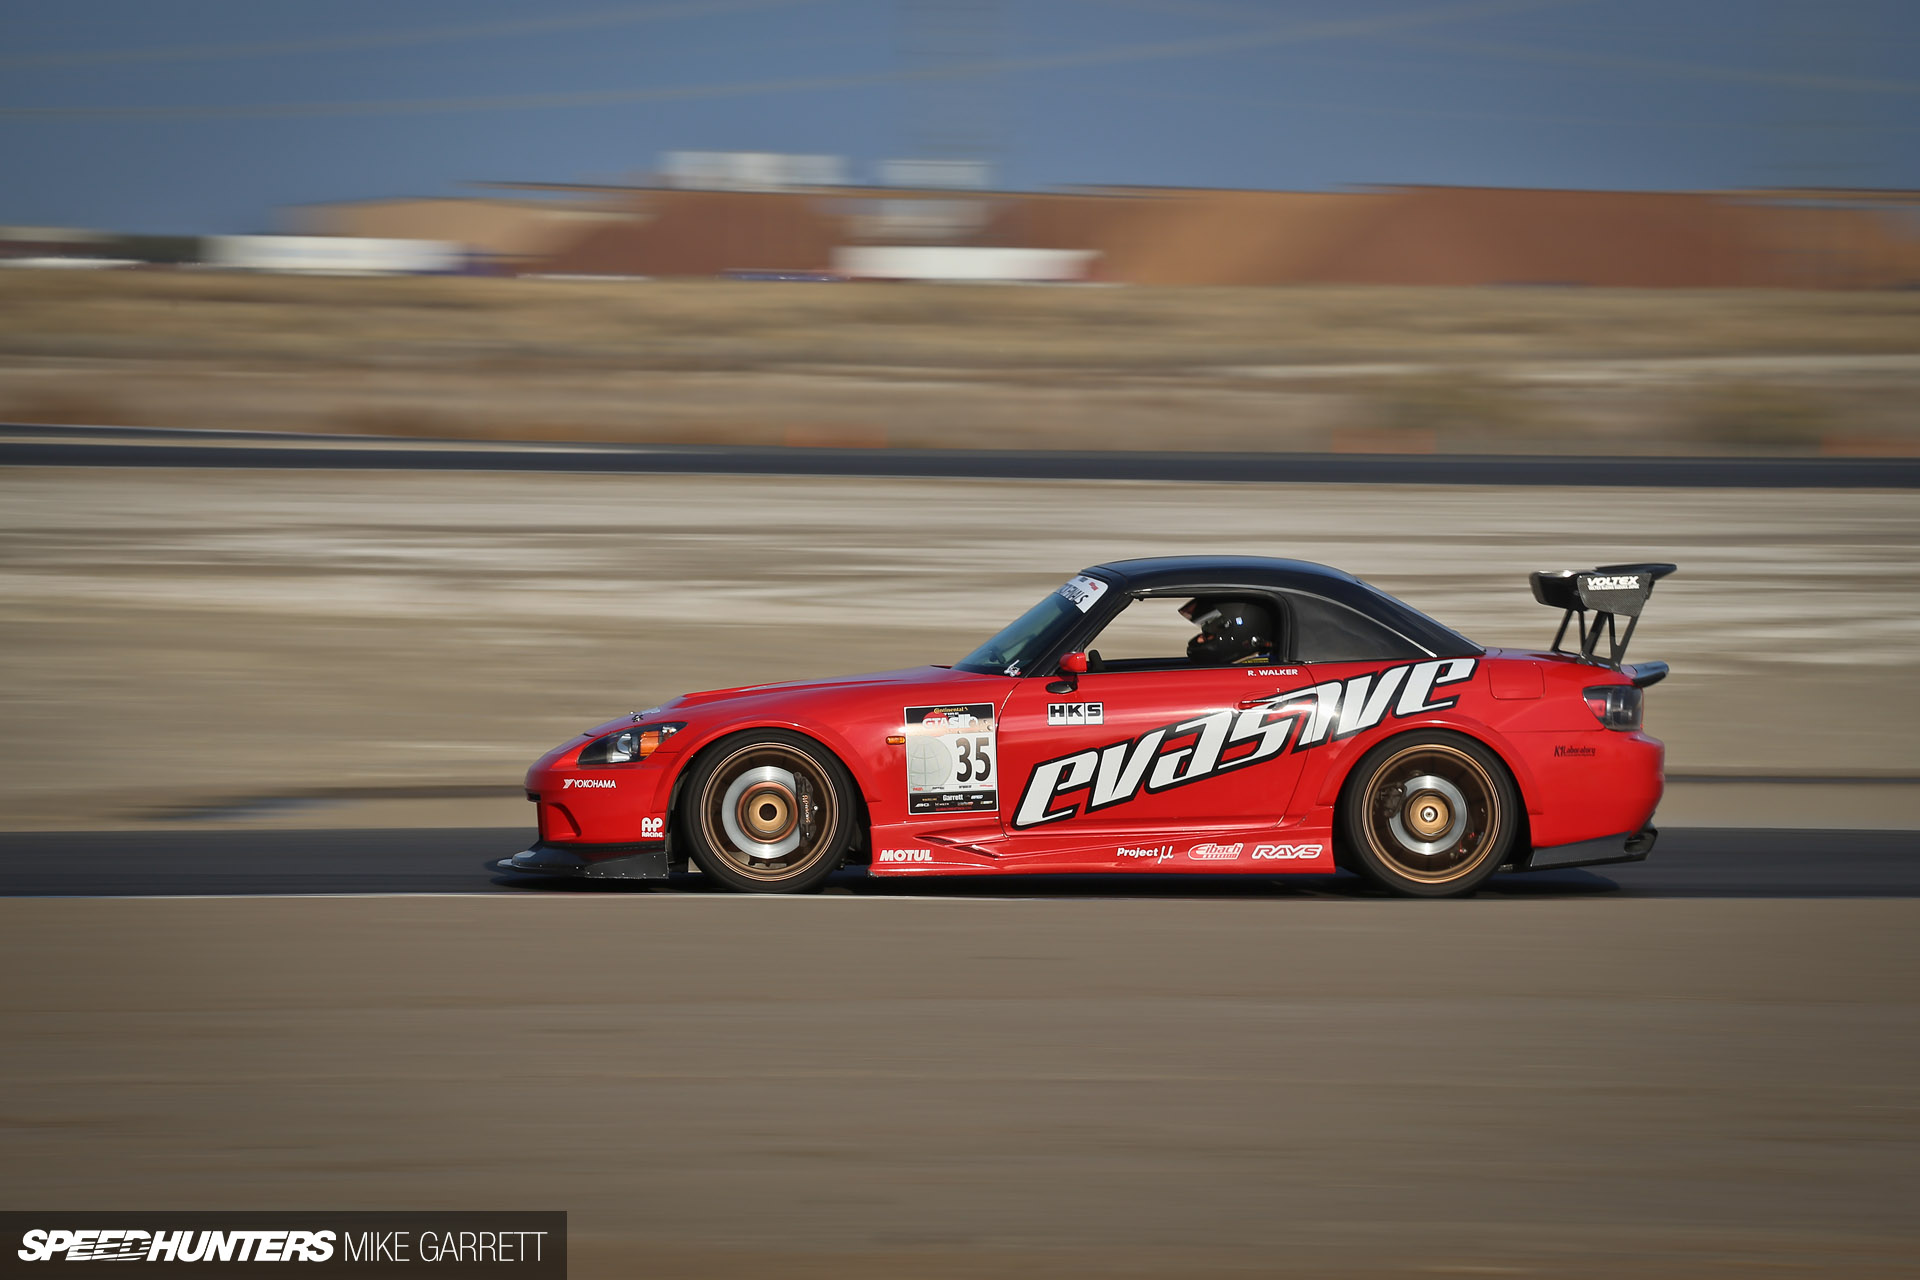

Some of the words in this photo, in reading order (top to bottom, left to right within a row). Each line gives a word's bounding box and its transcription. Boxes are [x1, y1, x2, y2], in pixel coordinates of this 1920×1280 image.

[1587, 576, 1639, 586] VOLTEX
[1050, 704, 1101, 717] HKS
[956, 737, 991, 782] 35
[574, 779, 616, 789] YOKOHAMA
[641, 817, 663, 832] AP
[879, 849, 933, 862] MOTUL
[1116, 847, 1159, 859] Project
[1188, 843, 1244, 860] Eibach
[1252, 844, 1322, 859] RAYS
